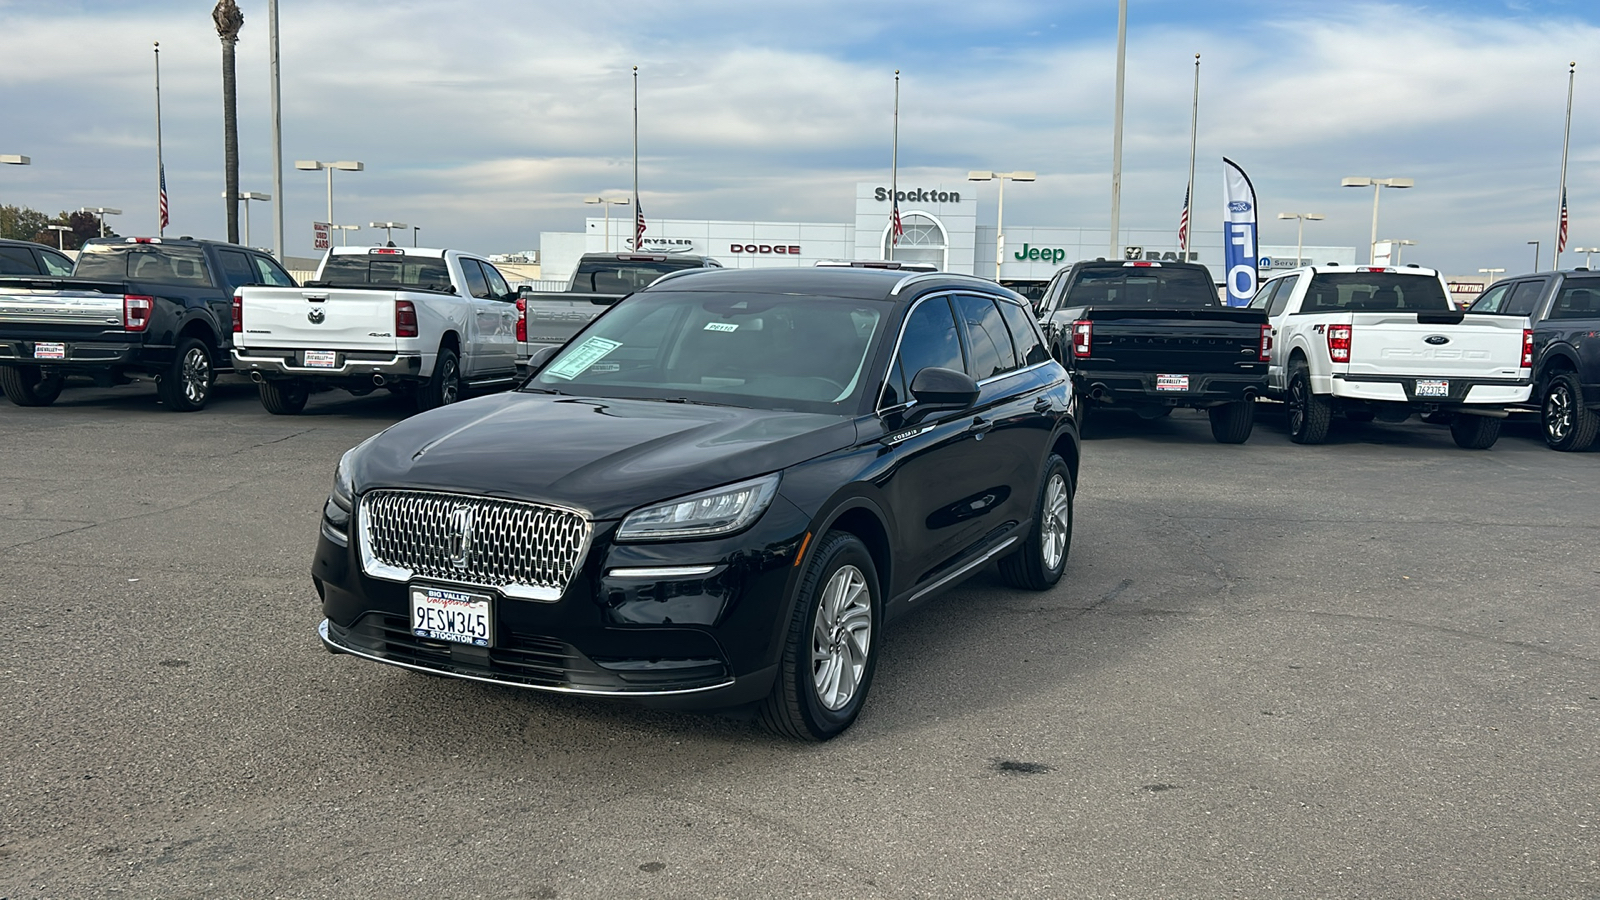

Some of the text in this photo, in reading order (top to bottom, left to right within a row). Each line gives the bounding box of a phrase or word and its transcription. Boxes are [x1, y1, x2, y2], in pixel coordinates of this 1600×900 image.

[875, 187, 960, 203] Stockton
[316, 231, 327, 239] USED
[315, 239, 328, 248] CARS
[730, 244, 801, 255] DODGE
[1014, 243, 1065, 264] Jeep
[1381, 348, 1491, 361] F-150
[893, 429, 917, 440] CORSAIR
[428, 590, 470, 602] BIG VALLEY
[427, 597, 476, 609] California
[417, 606, 486, 637] 9ESW345
[430, 630, 473, 644] STOCKTON
